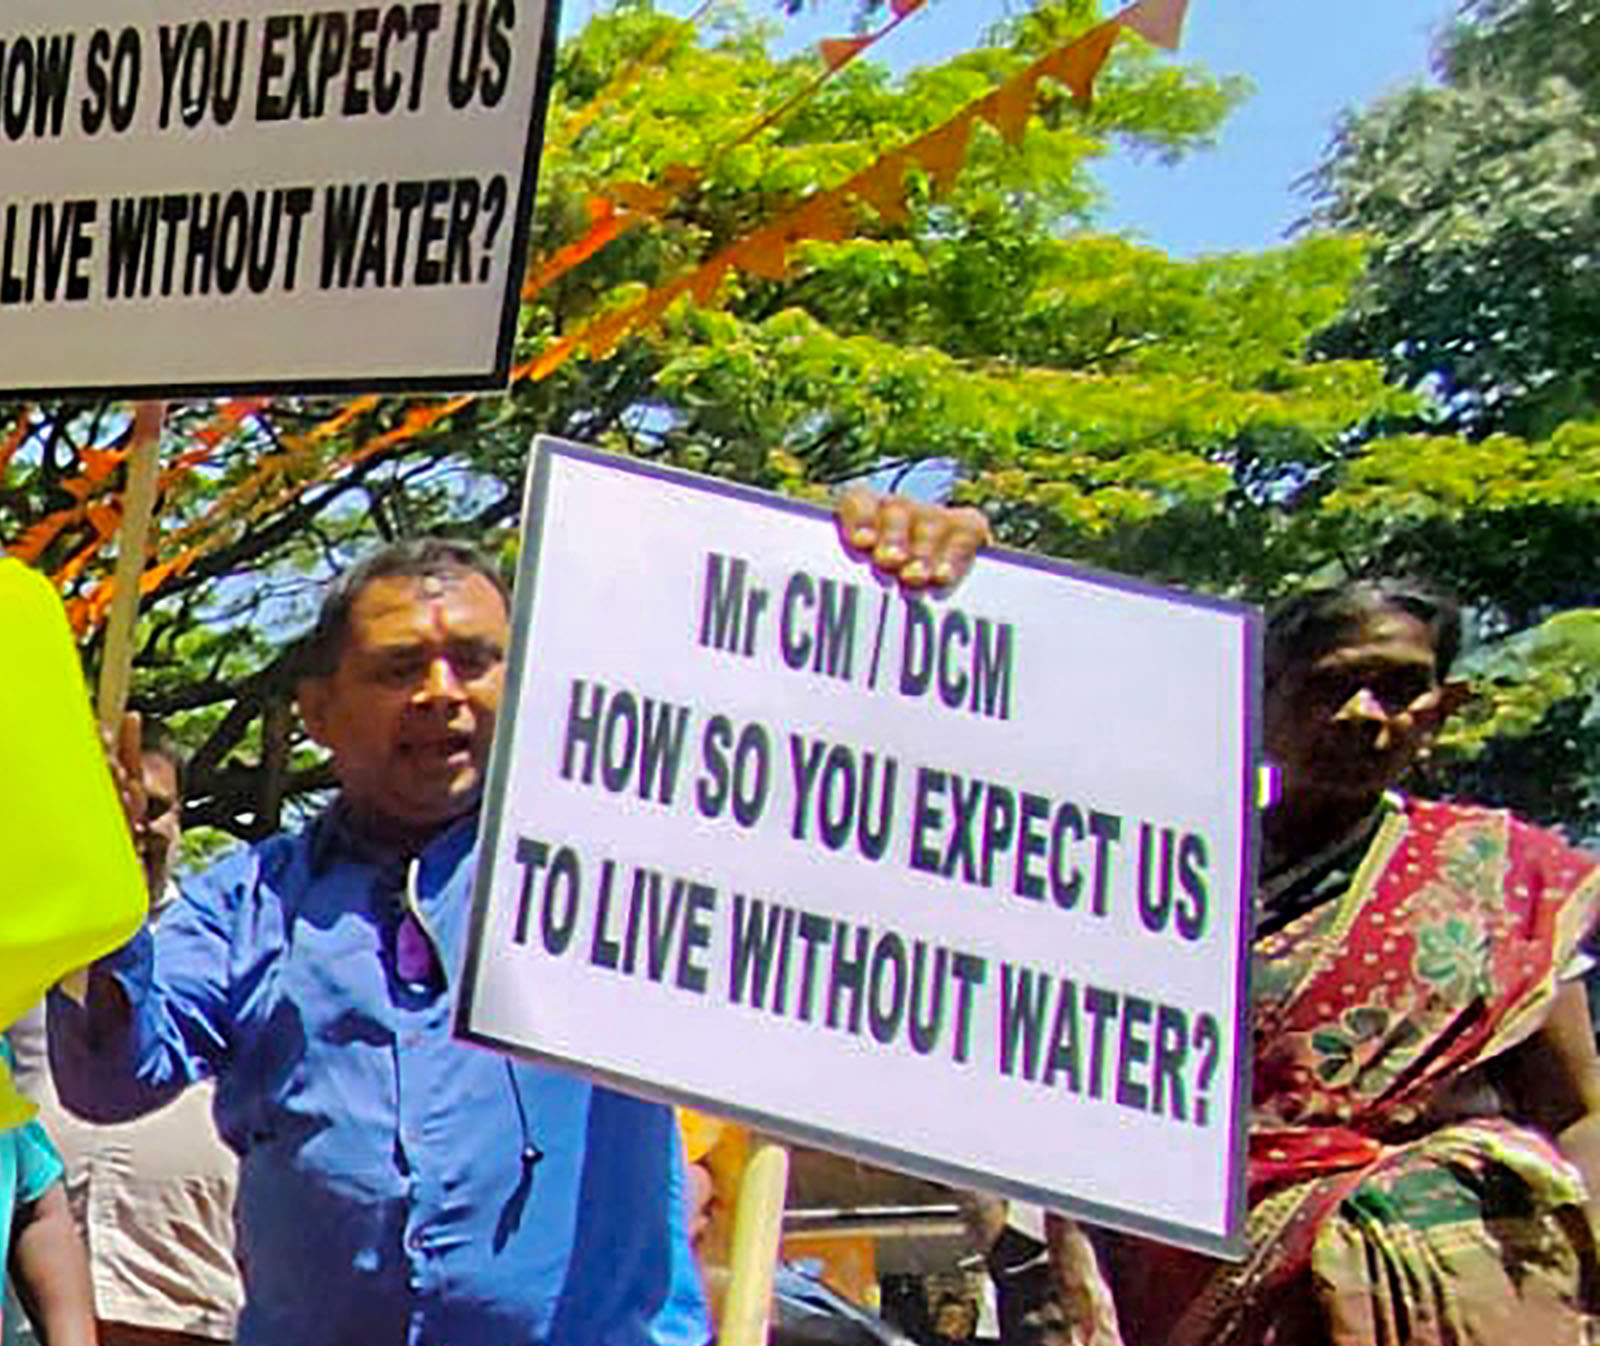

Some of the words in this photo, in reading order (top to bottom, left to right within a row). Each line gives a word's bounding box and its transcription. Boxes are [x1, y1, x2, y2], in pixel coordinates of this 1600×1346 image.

[81, 27, 141, 135] SO
[159, 19, 248, 129] YOU
[255, 3, 441, 121] EXPECT
[448, 0, 515, 109] US
[0, 200, 97, 304] LIVE
[107, 187, 314, 299] WITHOUT
[320, 175, 507, 290] WATER?
[700, 553, 766, 656] Mr
[781, 573, 857, 680] CM
[868, 593, 889, 688] /
[899, 600, 1011, 720] DCM
[561, 681, 689, 805] HOW
[697, 715, 768, 827] SO
[790, 734, 897, 860] YOU
[910, 768, 1120, 917] EXPECT
[1138, 823, 1207, 941] US
[514, 837, 580, 955] TO
[590, 860, 716, 993] LIVE
[730, 895, 985, 1063] WITHOUT
[1000, 963, 1219, 1126] WATER?
